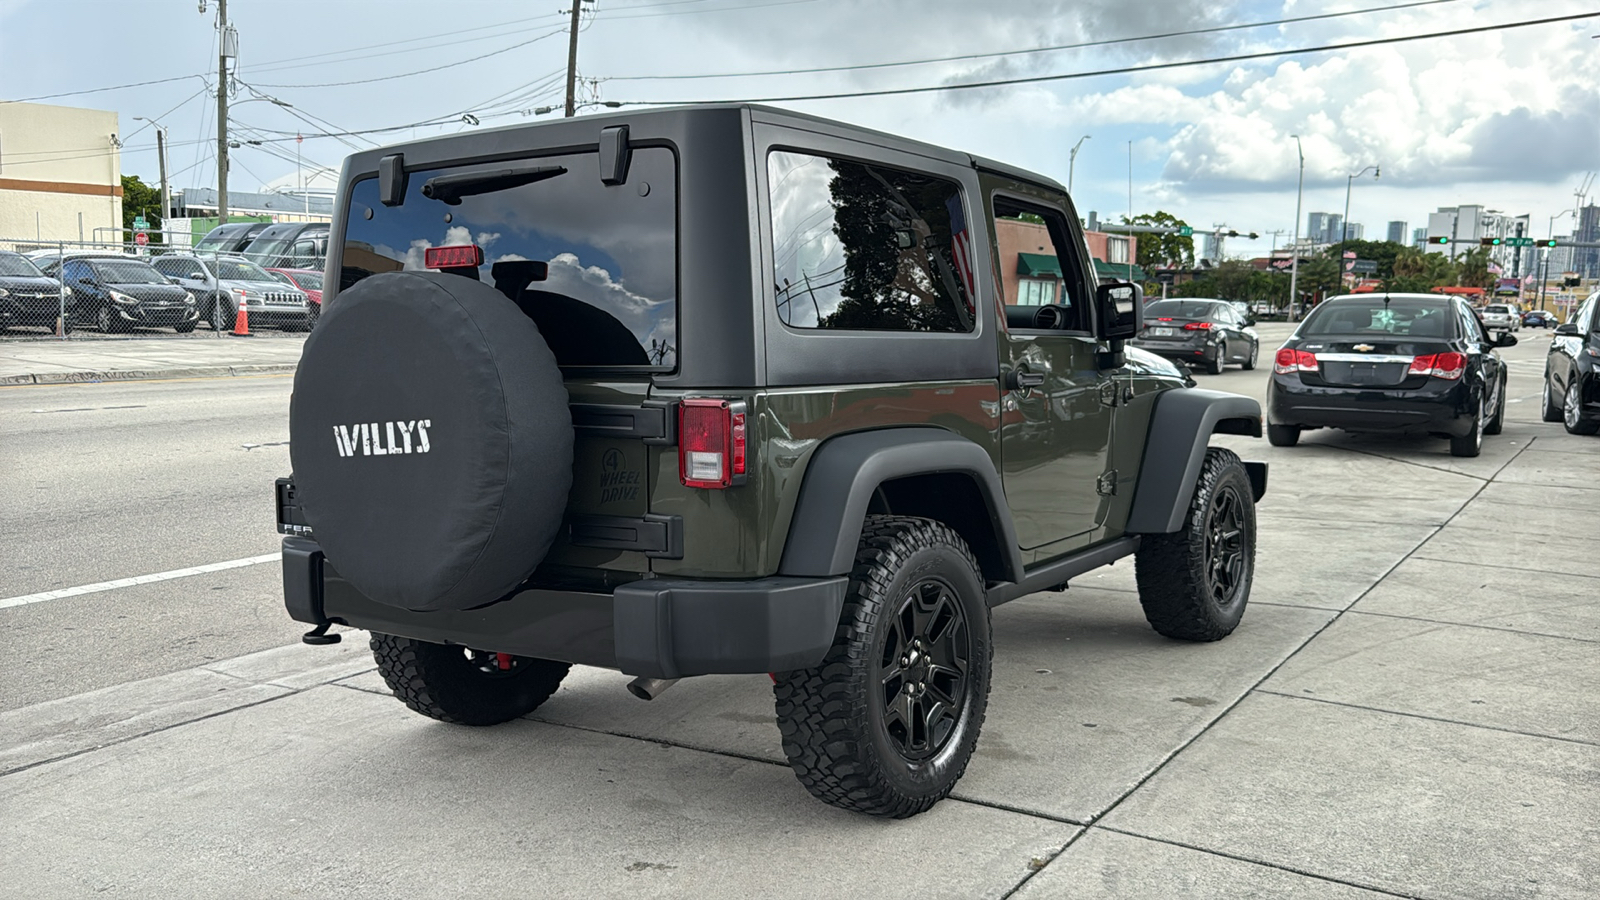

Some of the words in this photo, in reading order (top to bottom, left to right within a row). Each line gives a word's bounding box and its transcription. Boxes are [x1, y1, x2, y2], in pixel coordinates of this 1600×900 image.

[333, 419, 431, 457] WILLYS
[606, 451, 618, 471] 4
[600, 470, 641, 488] WHEEL
[600, 486, 640, 504] DRIVE
